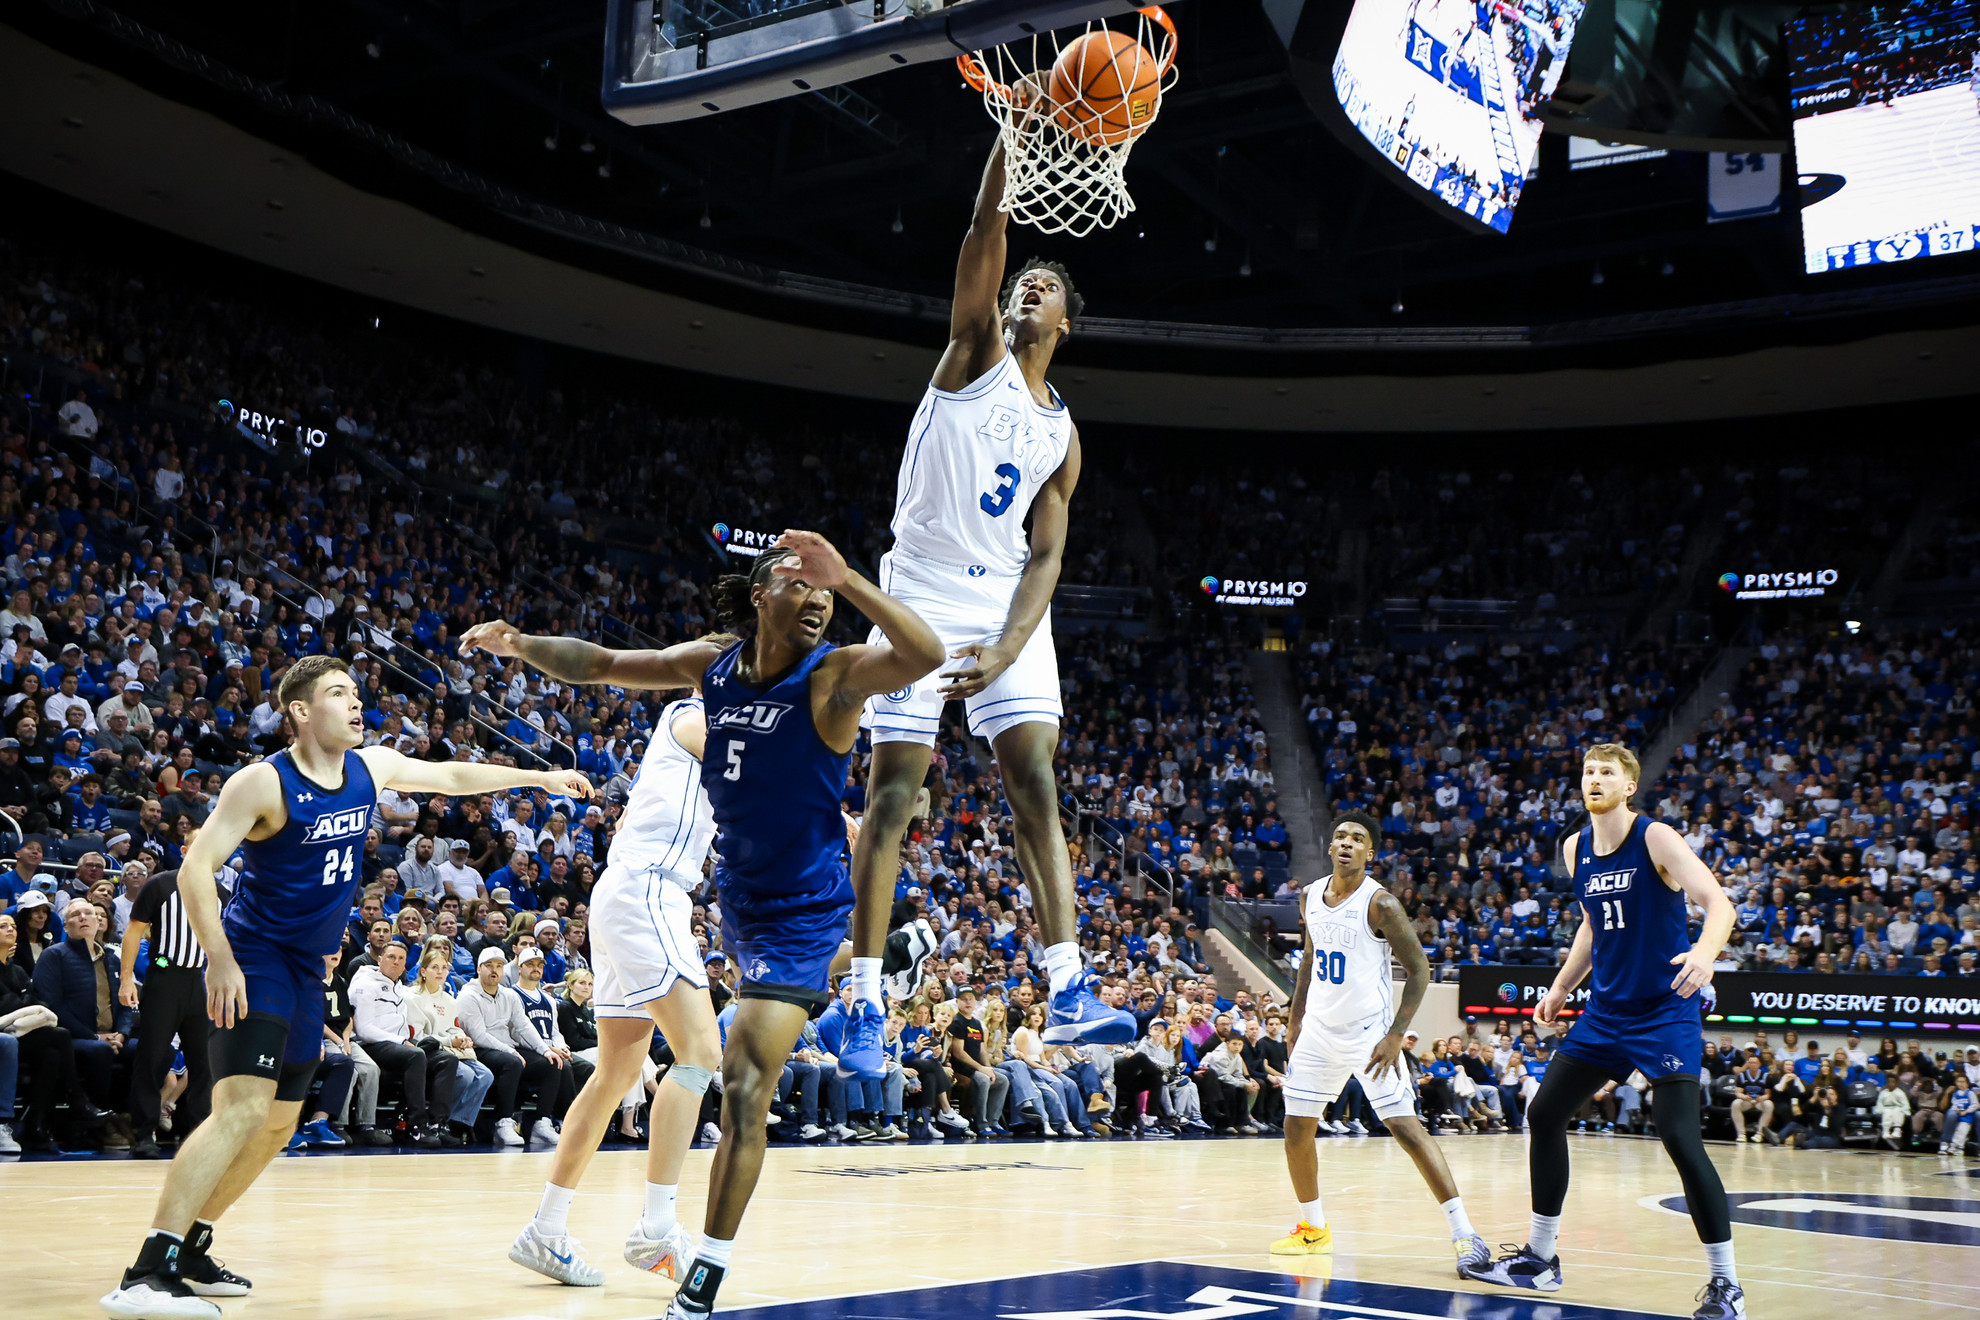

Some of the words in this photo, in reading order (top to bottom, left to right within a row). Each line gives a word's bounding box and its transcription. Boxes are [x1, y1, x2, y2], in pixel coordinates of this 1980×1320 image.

[1414, 159, 1431, 183] 33
[1939, 231, 1964, 251] 37
[240, 408, 302, 434] PRY
[978, 404, 1050, 484] BYU
[980, 463, 1021, 518] 3
[713, 705, 781, 728] ACU
[723, 739, 746, 782] 5
[311, 811, 365, 840] ACU
[322, 845, 355, 886] 24
[1588, 872, 1631, 893] ACU
[1602, 900, 1625, 930] 21
[1316, 949, 1346, 985] 30
[325, 991, 341, 1018] 7
[1523, 985, 1592, 1003] PRSM
[1750, 992, 1793, 1009] YOU
[1796, 993, 1888, 1013] DESERVE
[1891, 996, 1921, 1014] TO
[540, 1020, 550, 1038] 1
